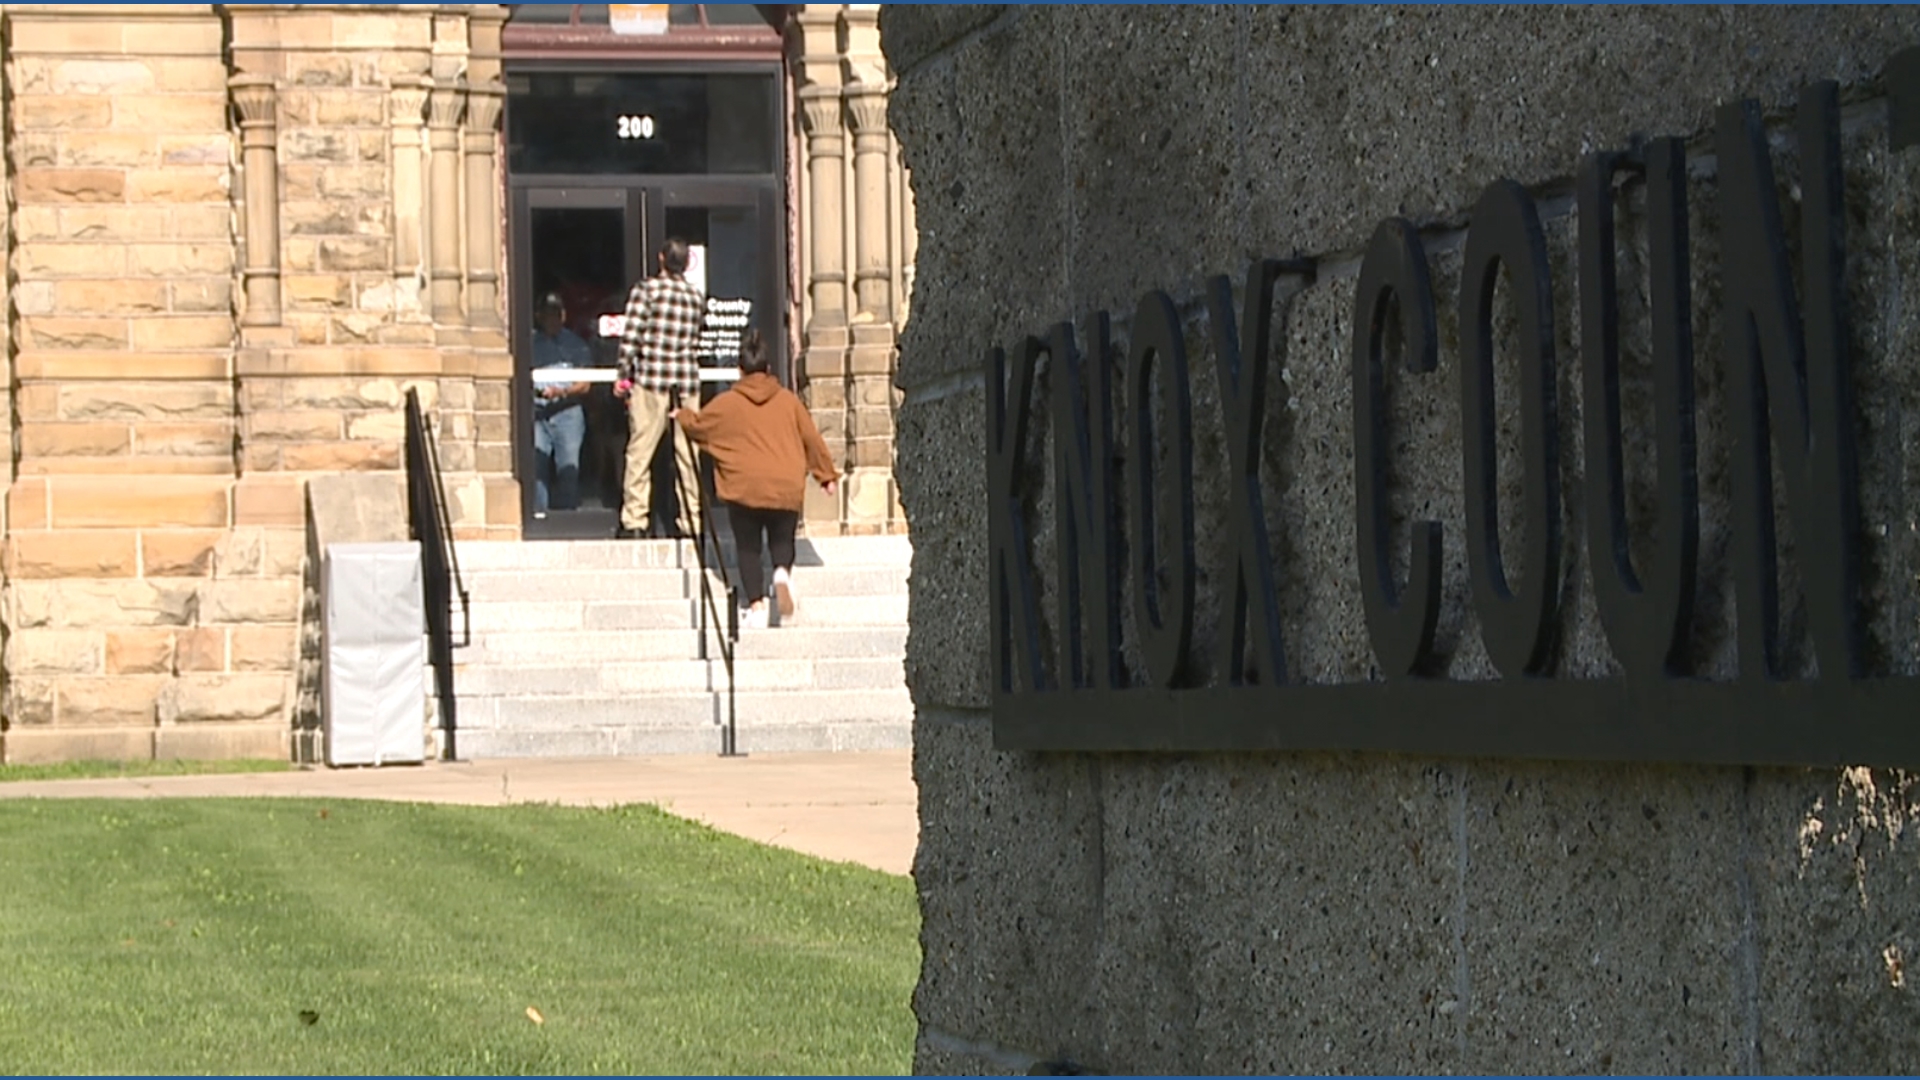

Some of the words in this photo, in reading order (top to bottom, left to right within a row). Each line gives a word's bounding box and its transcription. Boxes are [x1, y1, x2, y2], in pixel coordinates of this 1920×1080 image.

[617, 115, 654, 138] 200
[707, 297, 752, 315] County
[705, 314, 748, 328] thouse
[985, 257, 1300, 690] KNOX
[1353, 49, 1920, 682] COUN
